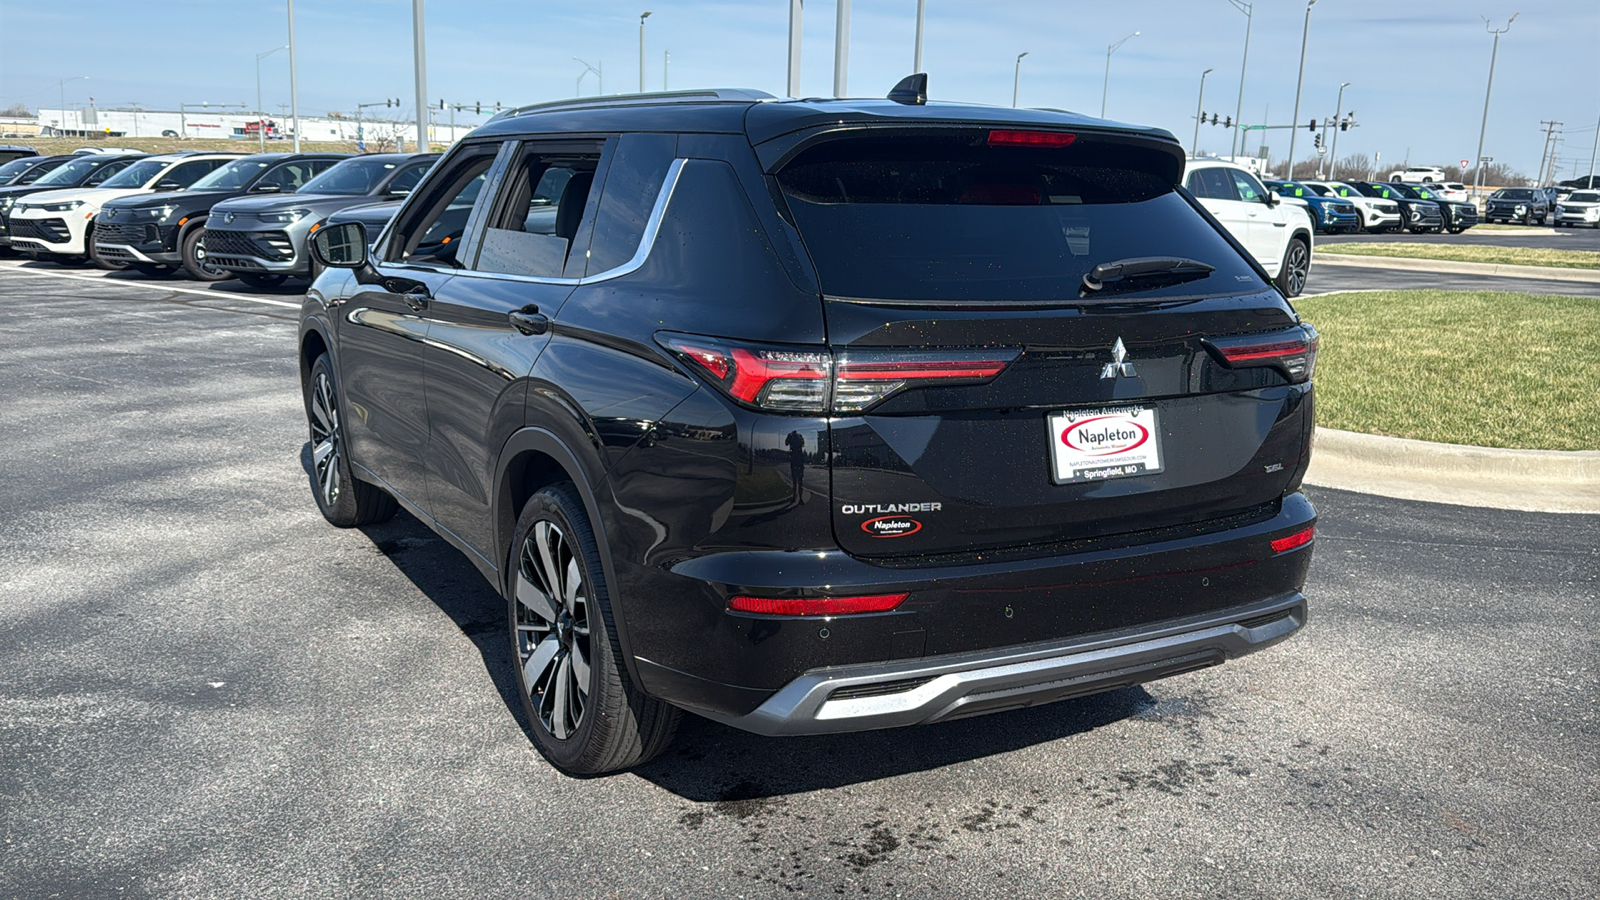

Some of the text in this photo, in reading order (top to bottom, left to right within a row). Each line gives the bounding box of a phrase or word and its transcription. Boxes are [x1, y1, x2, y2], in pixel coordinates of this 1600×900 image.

[1063, 404, 1144, 418] Napleton Autowerks
[1078, 427, 1136, 445] Napleton
[1084, 465, 1137, 479] Springfield, MO
[841, 502, 942, 514] OUTLANDER
[874, 520, 911, 530] Napleton
